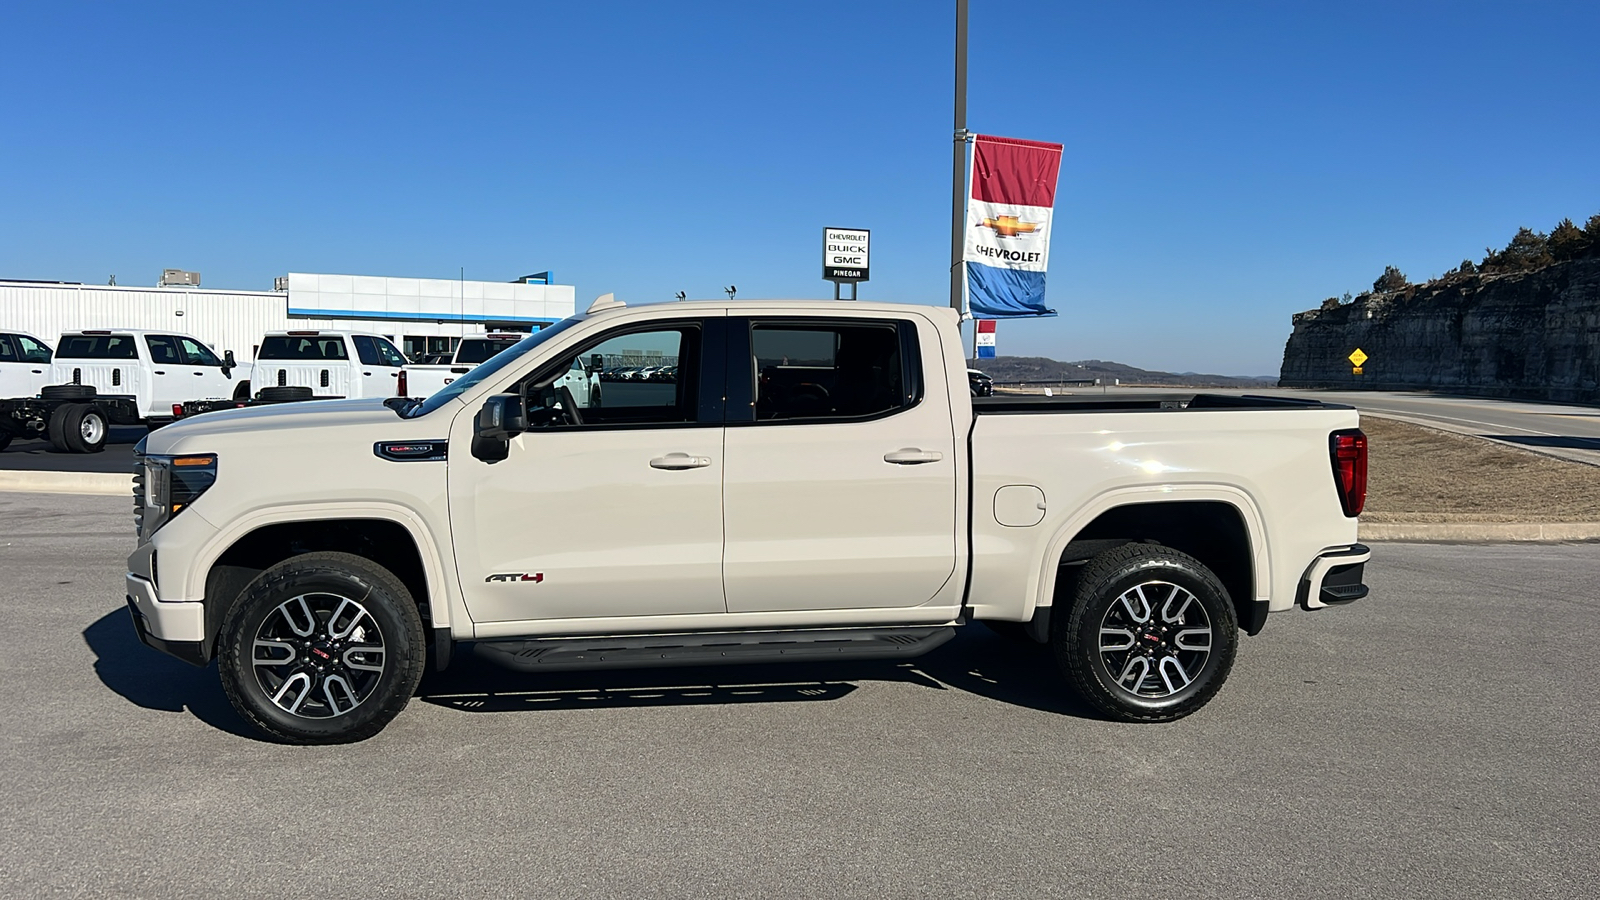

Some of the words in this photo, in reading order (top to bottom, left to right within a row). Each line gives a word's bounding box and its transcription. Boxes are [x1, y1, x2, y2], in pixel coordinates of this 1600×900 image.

[829, 233, 866, 241] CHEVROLET
[828, 245, 866, 253] BUICK
[976, 244, 1041, 262] CHEVROLET
[833, 256, 861, 264] GMC
[833, 269, 861, 277] PINEGAR
[485, 573, 543, 584] AT4
